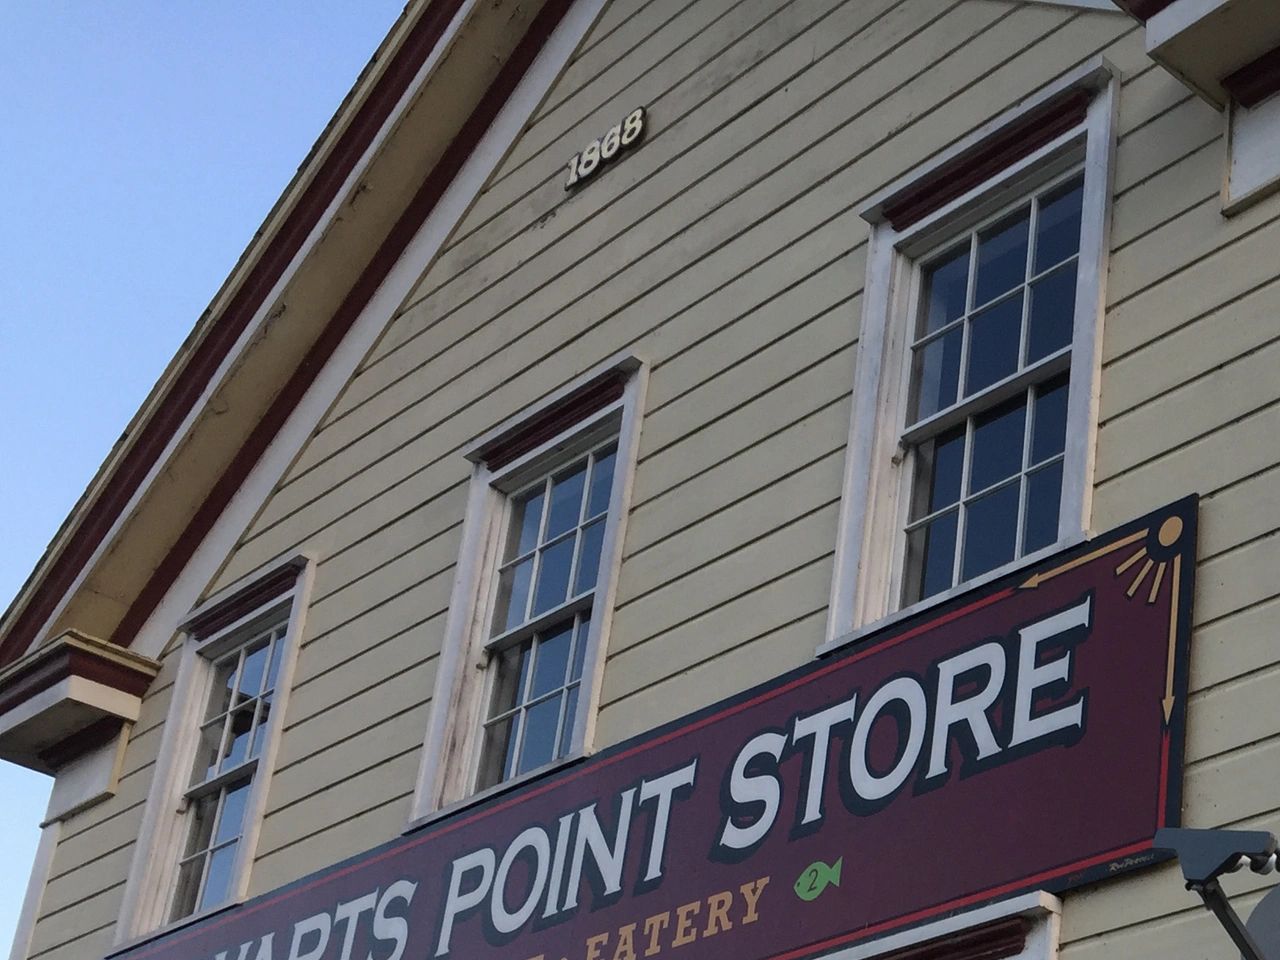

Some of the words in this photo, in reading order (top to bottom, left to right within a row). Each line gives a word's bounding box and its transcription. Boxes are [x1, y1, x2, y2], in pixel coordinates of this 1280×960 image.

[566, 106, 645, 189] 1868
[434, 758, 698, 957] POINT
[719, 595, 1092, 850] STORE
